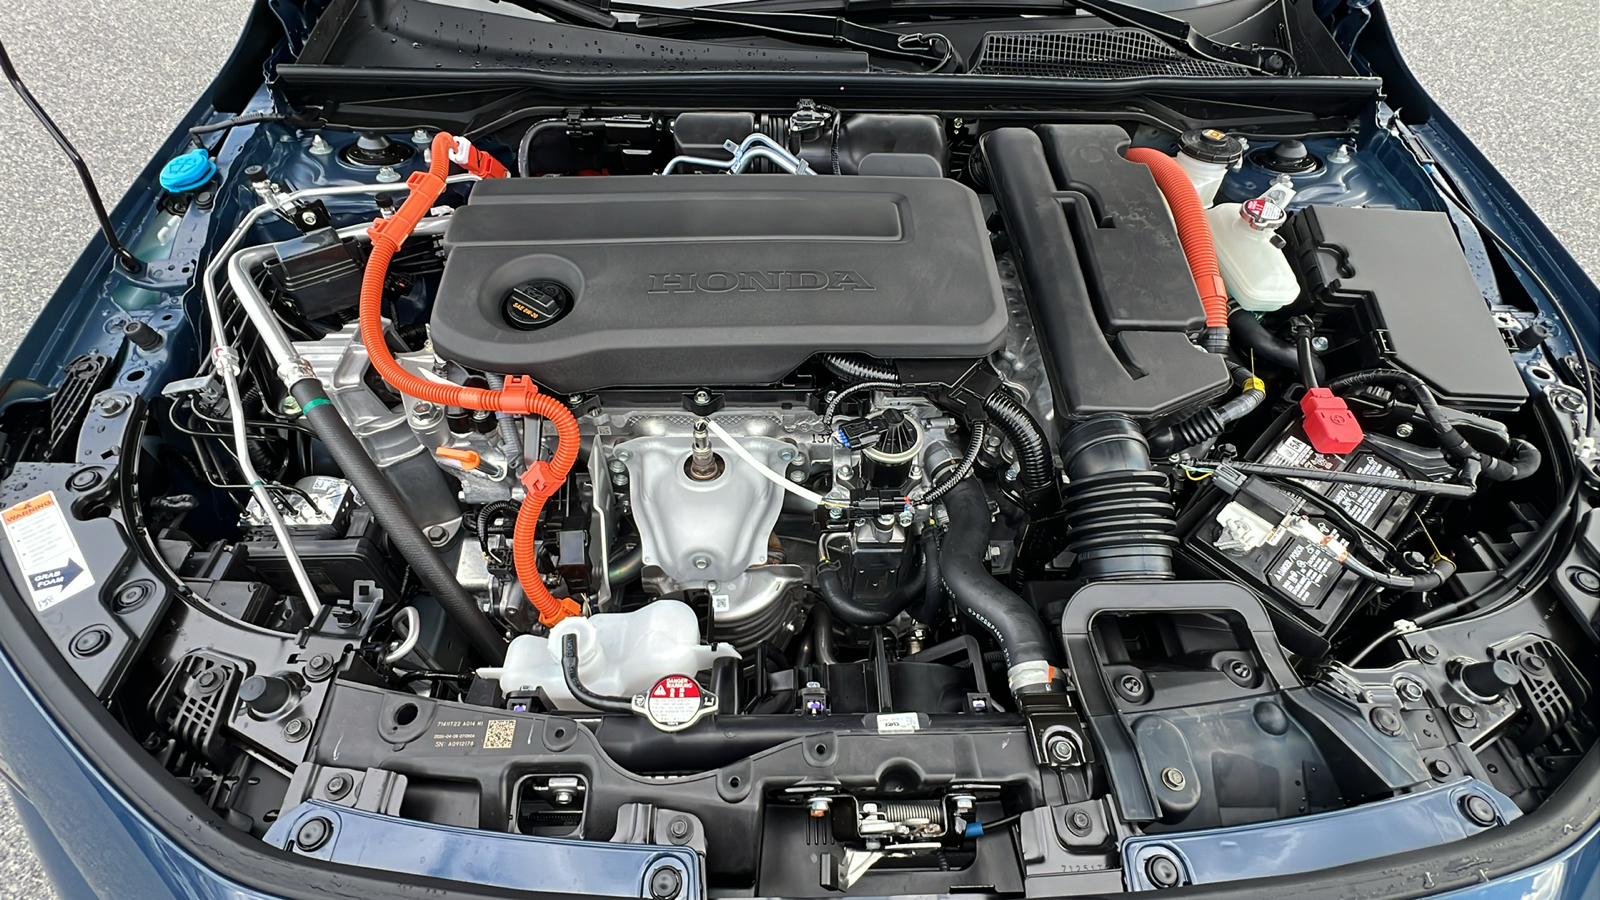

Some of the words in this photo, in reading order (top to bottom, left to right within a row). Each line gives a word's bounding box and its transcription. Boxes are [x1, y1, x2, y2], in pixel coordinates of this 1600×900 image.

[647, 270, 877, 294] HONDA
[512, 302, 524, 311] SAE
[811, 433, 832, 444] 137
[6, 500, 52, 522] WARNING
[34, 570, 61, 582] GRAB
[37, 576, 64, 588] FOAM
